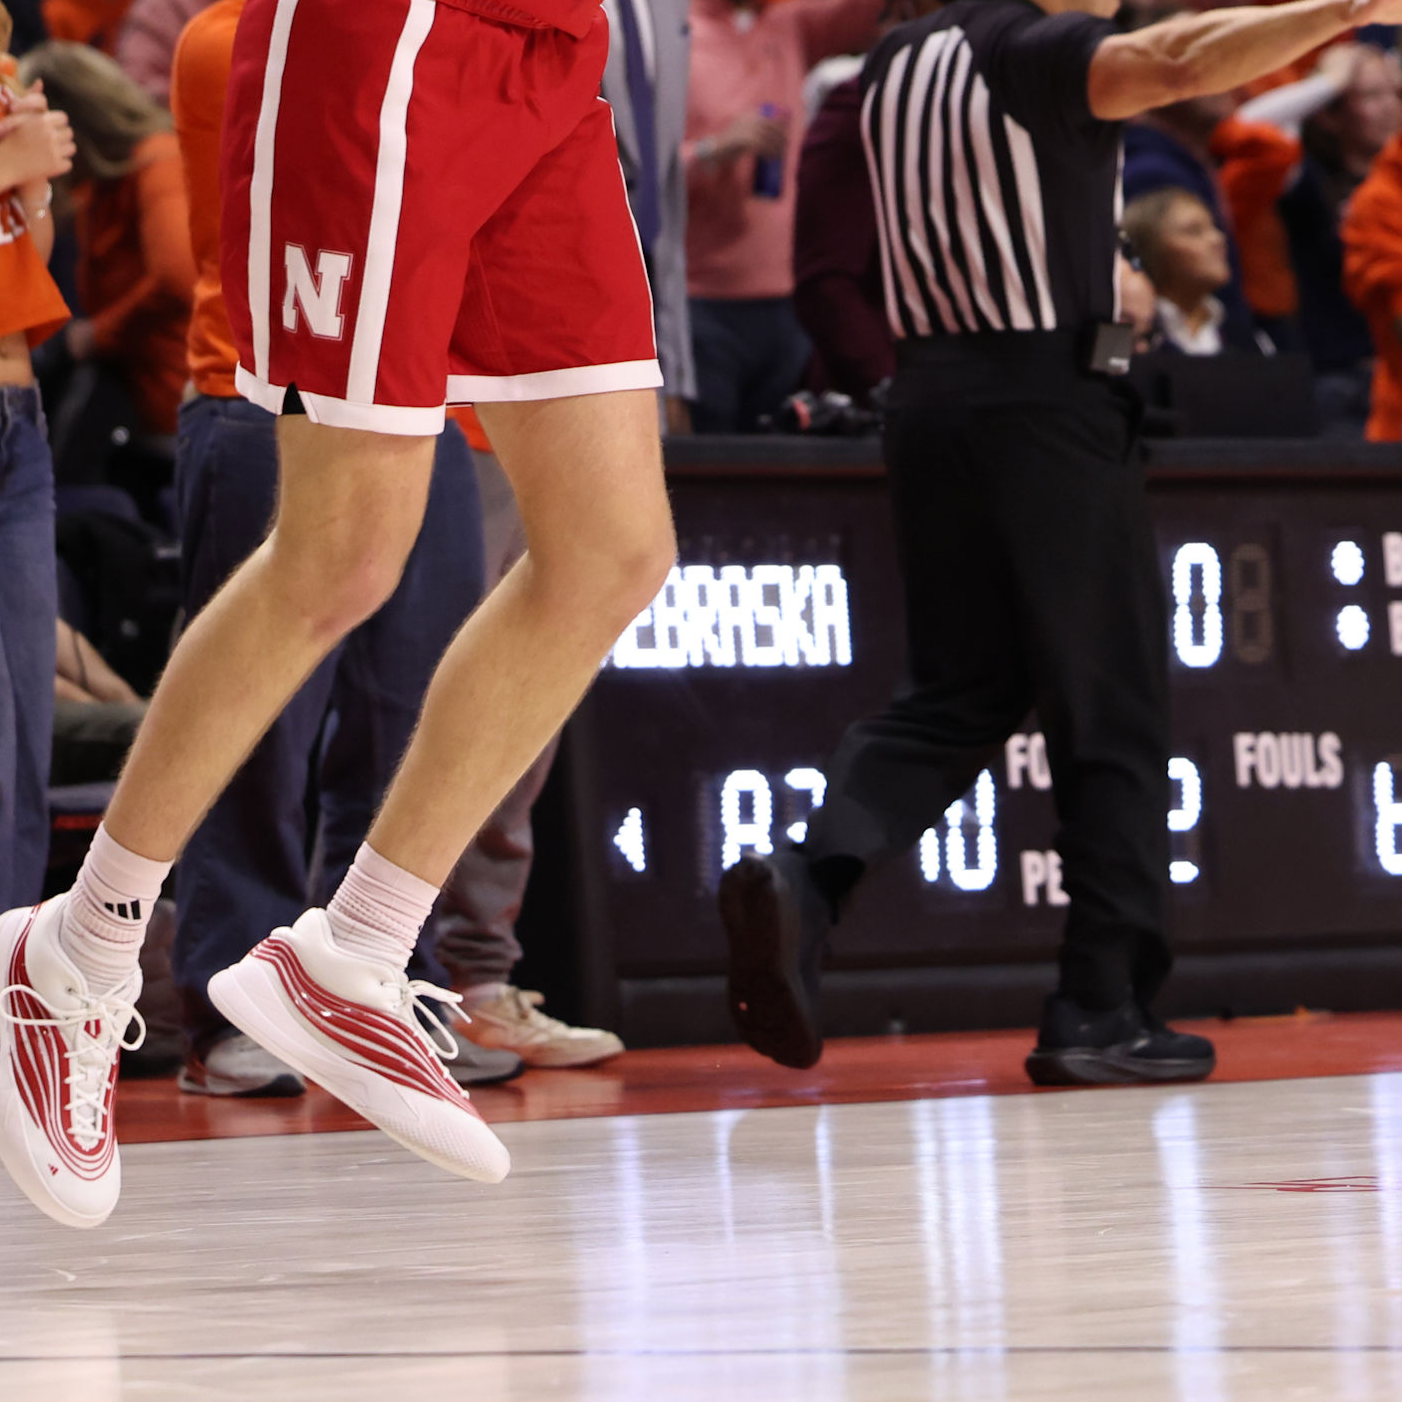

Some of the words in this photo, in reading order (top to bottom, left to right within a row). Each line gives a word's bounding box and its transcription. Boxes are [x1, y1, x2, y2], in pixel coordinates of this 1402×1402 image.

[281, 241, 354, 342] N
[606, 563, 853, 669] EBRASKA
[1232, 730, 1344, 789] FOULS
